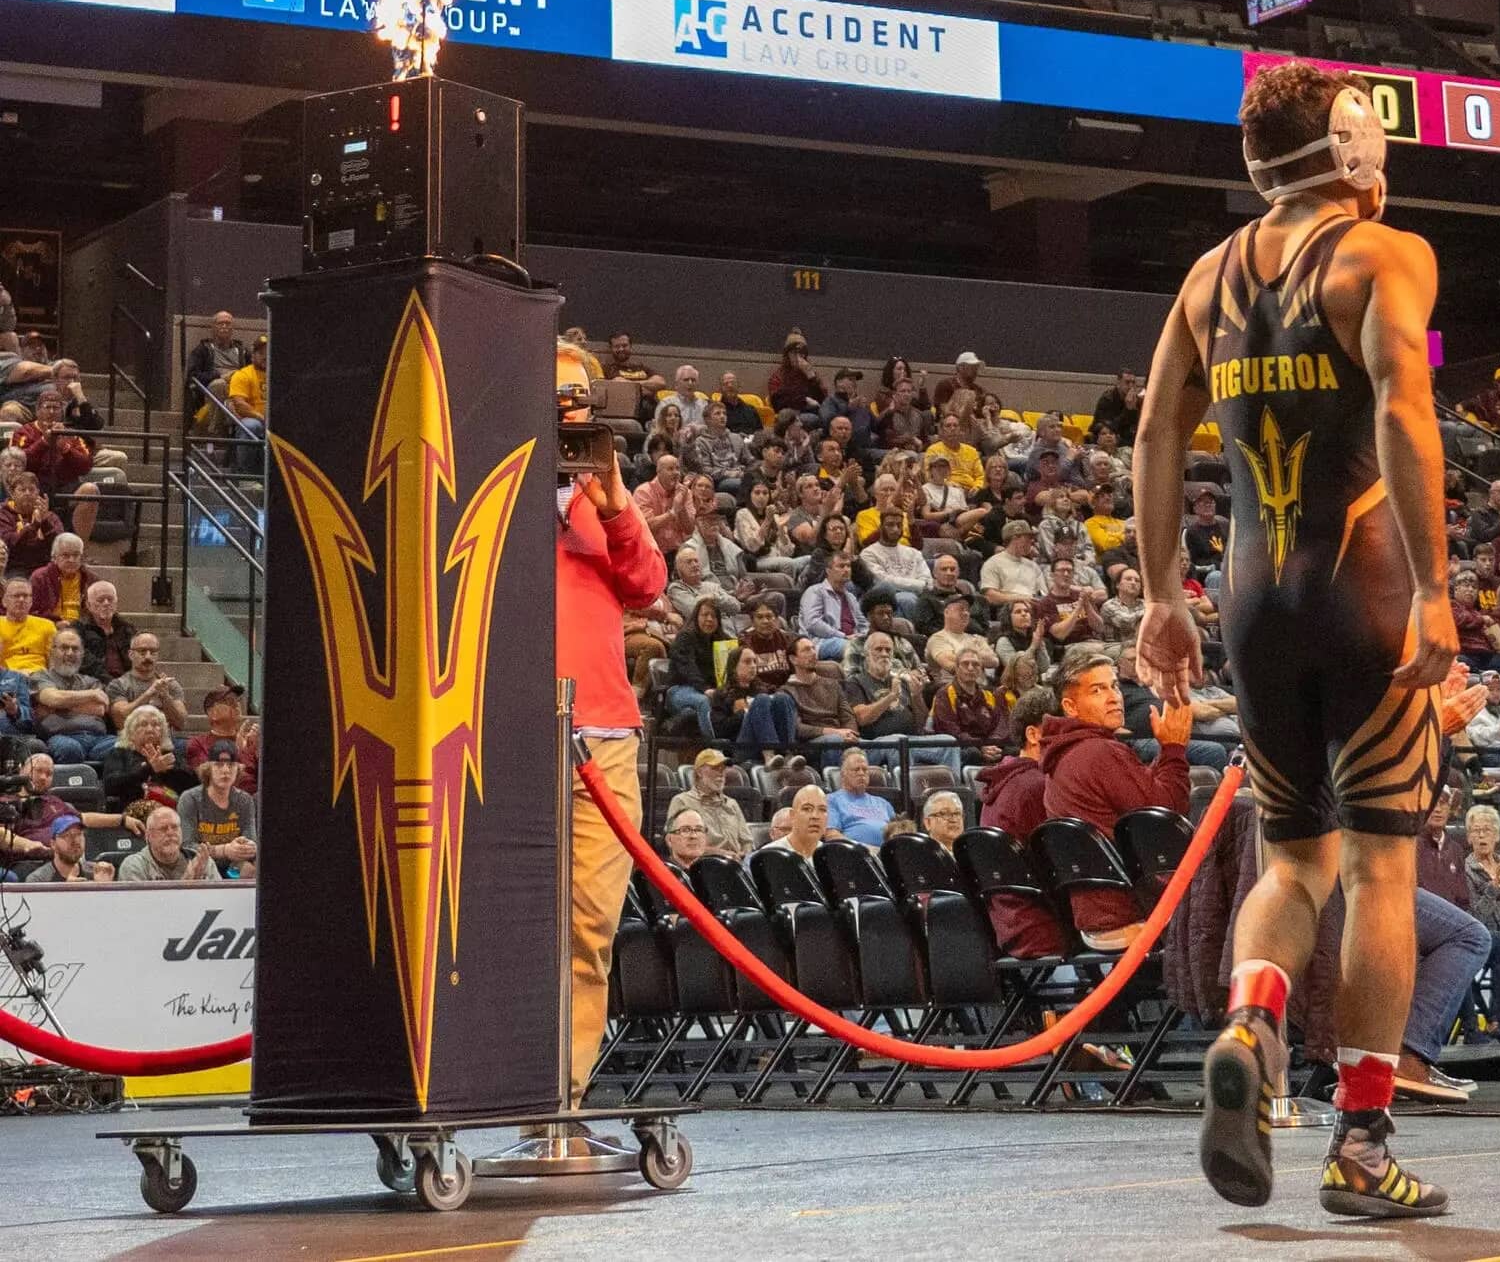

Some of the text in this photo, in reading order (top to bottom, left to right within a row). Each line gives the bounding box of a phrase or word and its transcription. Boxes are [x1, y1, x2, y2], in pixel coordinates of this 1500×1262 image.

[742, 4, 946, 53] ACCIDENT
[742, 40, 801, 68] LAW
[1464, 95, 1491, 140] 0
[793, 270, 820, 290] 111
[1211, 353, 1340, 403] FIGUEROA
[163, 993, 196, 1016] The
[201, 993, 239, 1025] King
